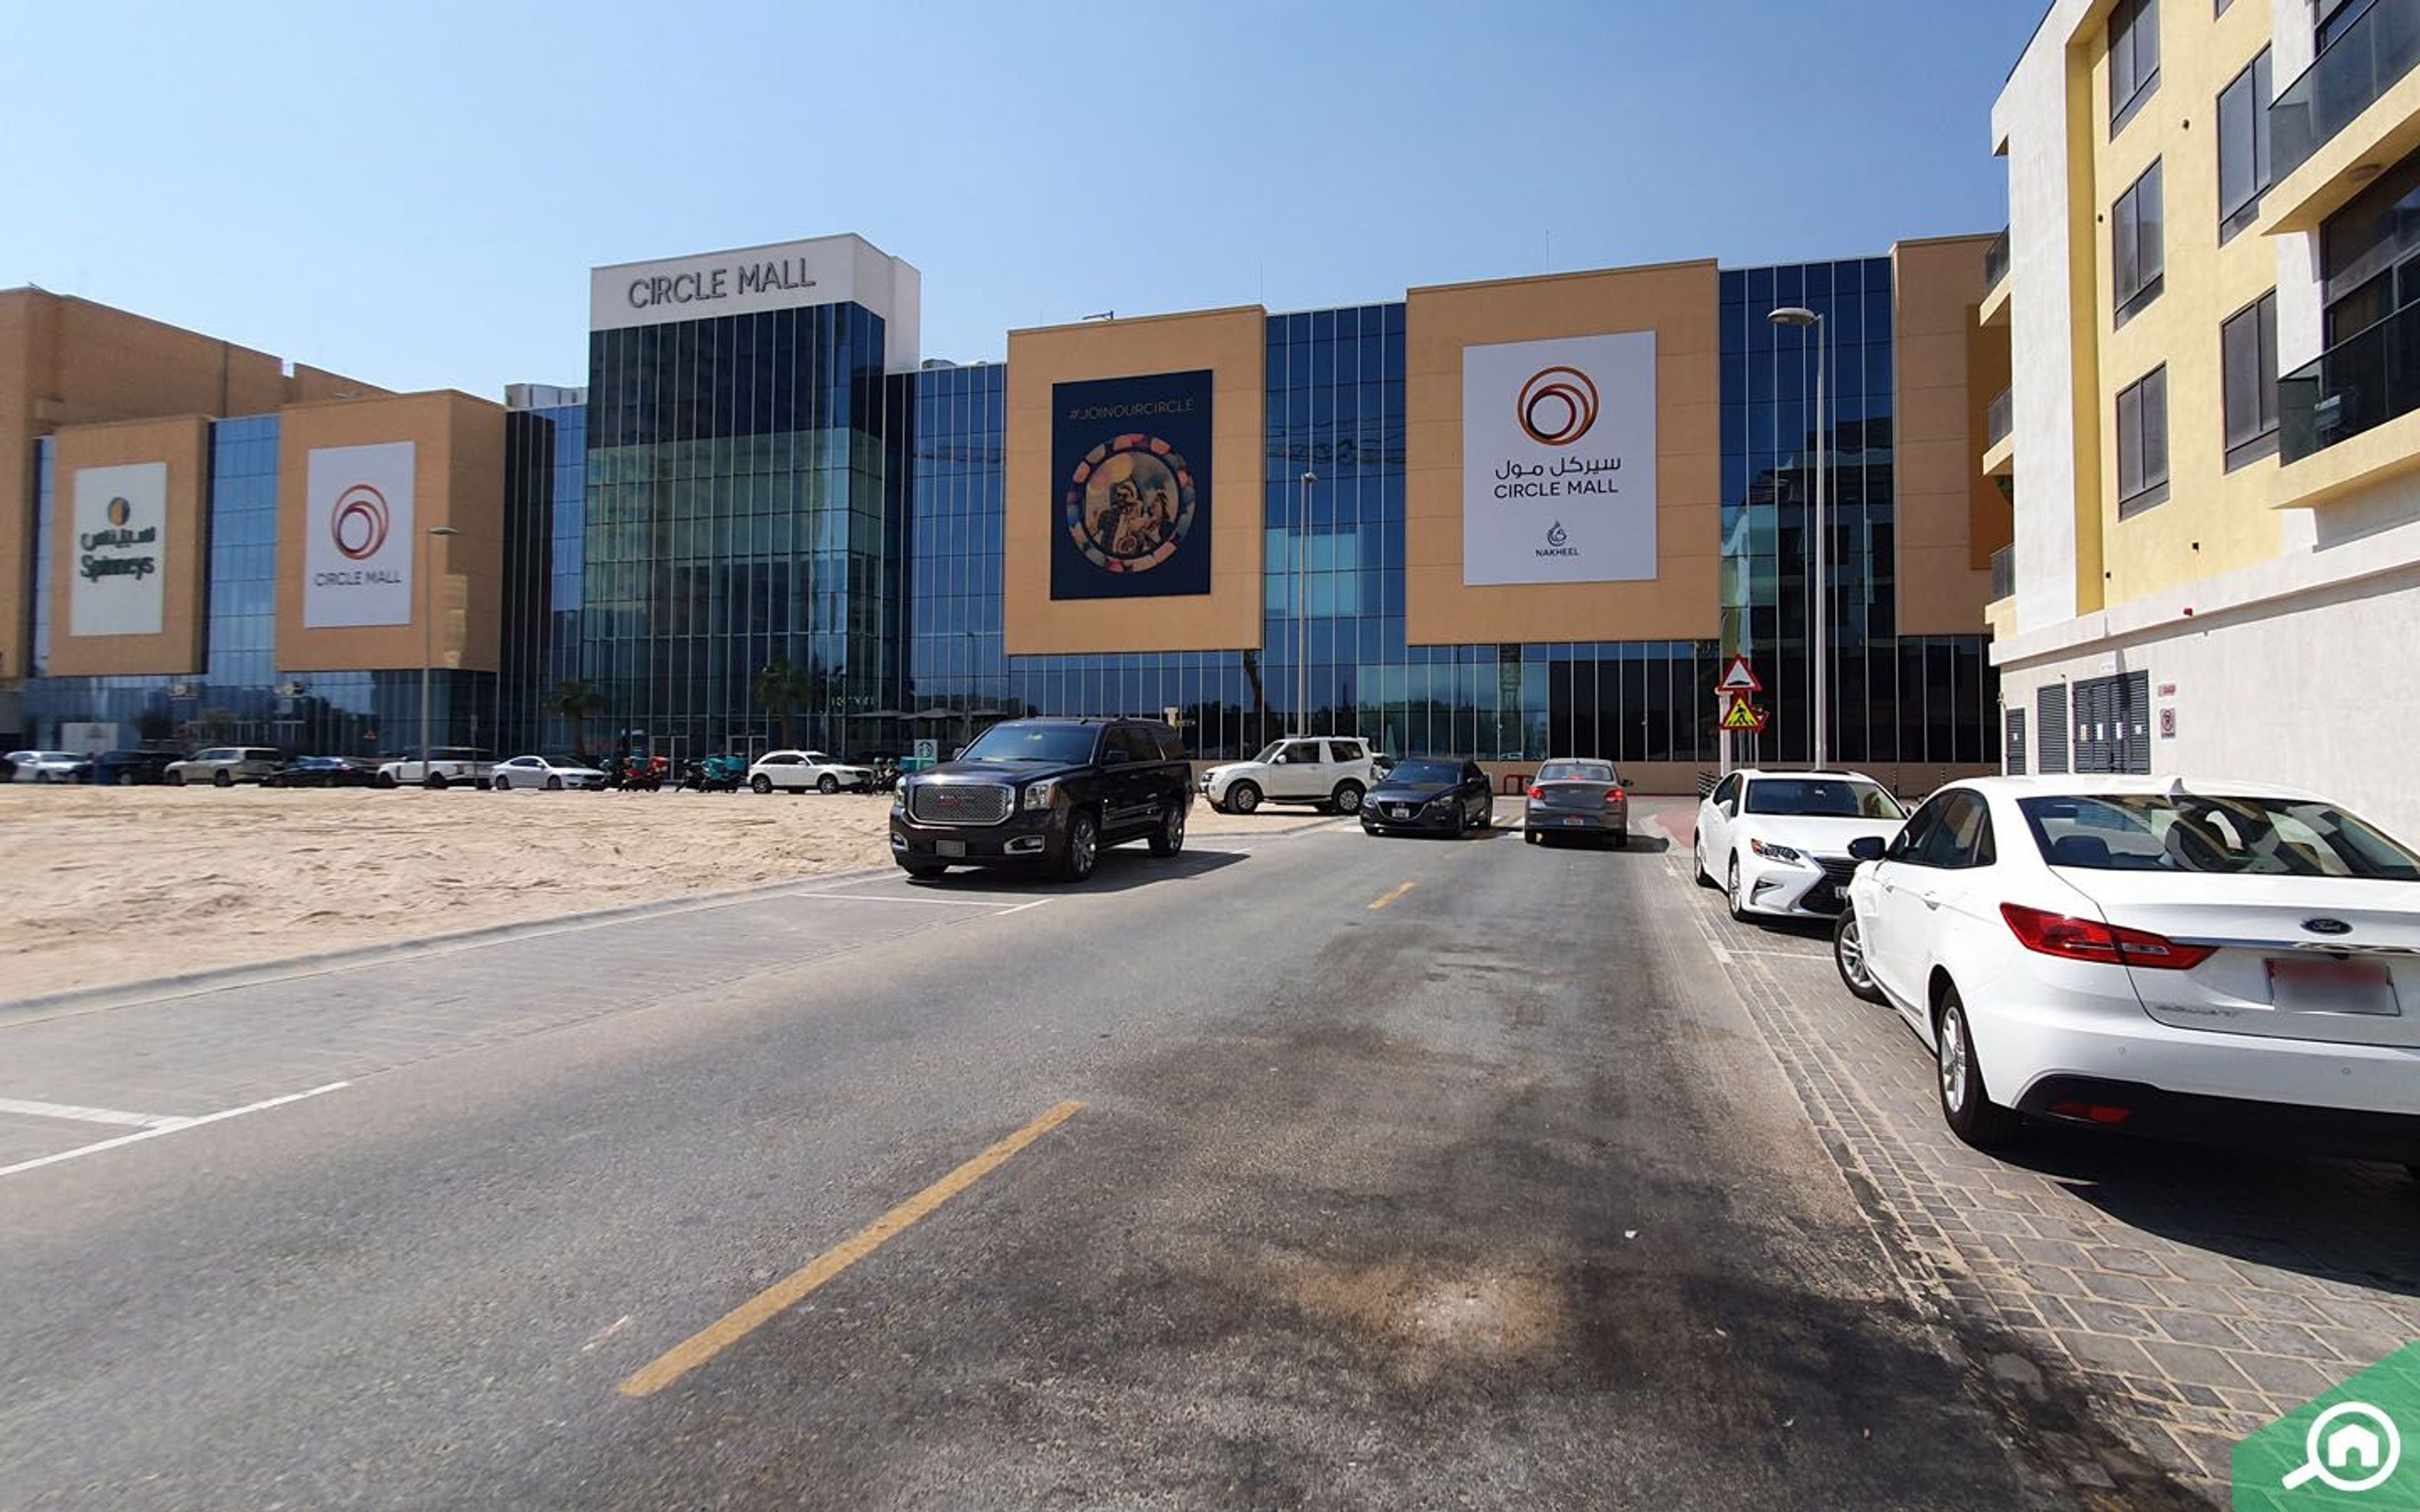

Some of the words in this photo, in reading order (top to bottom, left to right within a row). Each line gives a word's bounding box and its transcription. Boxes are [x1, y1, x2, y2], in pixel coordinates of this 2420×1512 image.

[629, 269, 727, 309] CIRCLE
[738, 257, 817, 295] MALL
[1069, 398, 1195, 421] #JOINOURCIRCLE
[1495, 460, 1544, 480] مول
[1550, 456, 1621, 477] سيركل
[1494, 481, 1561, 498] CIRCLE
[1567, 478, 1619, 495] MALL
[1535, 547, 1580, 557] NAKHEEL
[80, 554, 155, 583] Spinneys
[315, 571, 362, 586] CIRCLE
[366, 570, 402, 584] MALL
